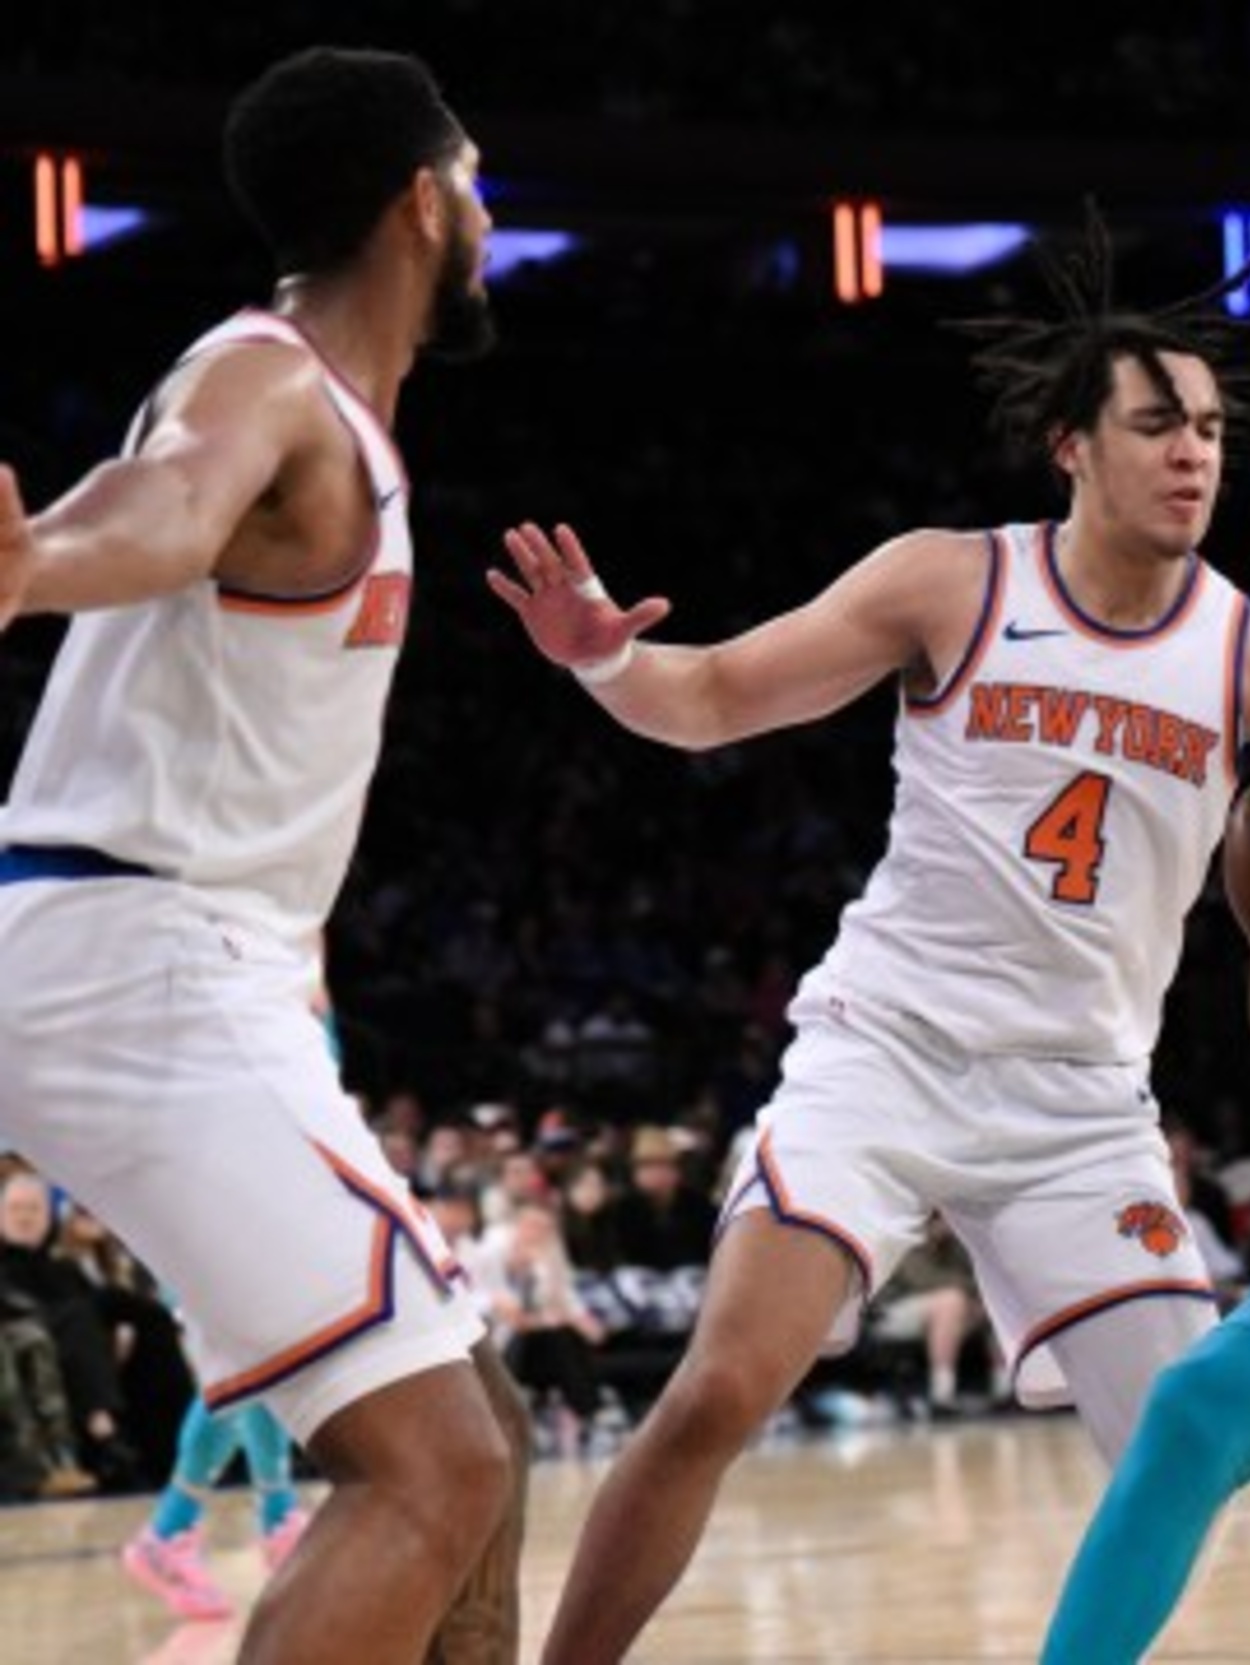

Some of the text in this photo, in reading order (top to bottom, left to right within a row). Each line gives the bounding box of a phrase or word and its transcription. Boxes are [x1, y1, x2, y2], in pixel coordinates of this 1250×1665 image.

[965, 682, 1220, 788] NEW YORK
[1023, 769, 1113, 904] 4
